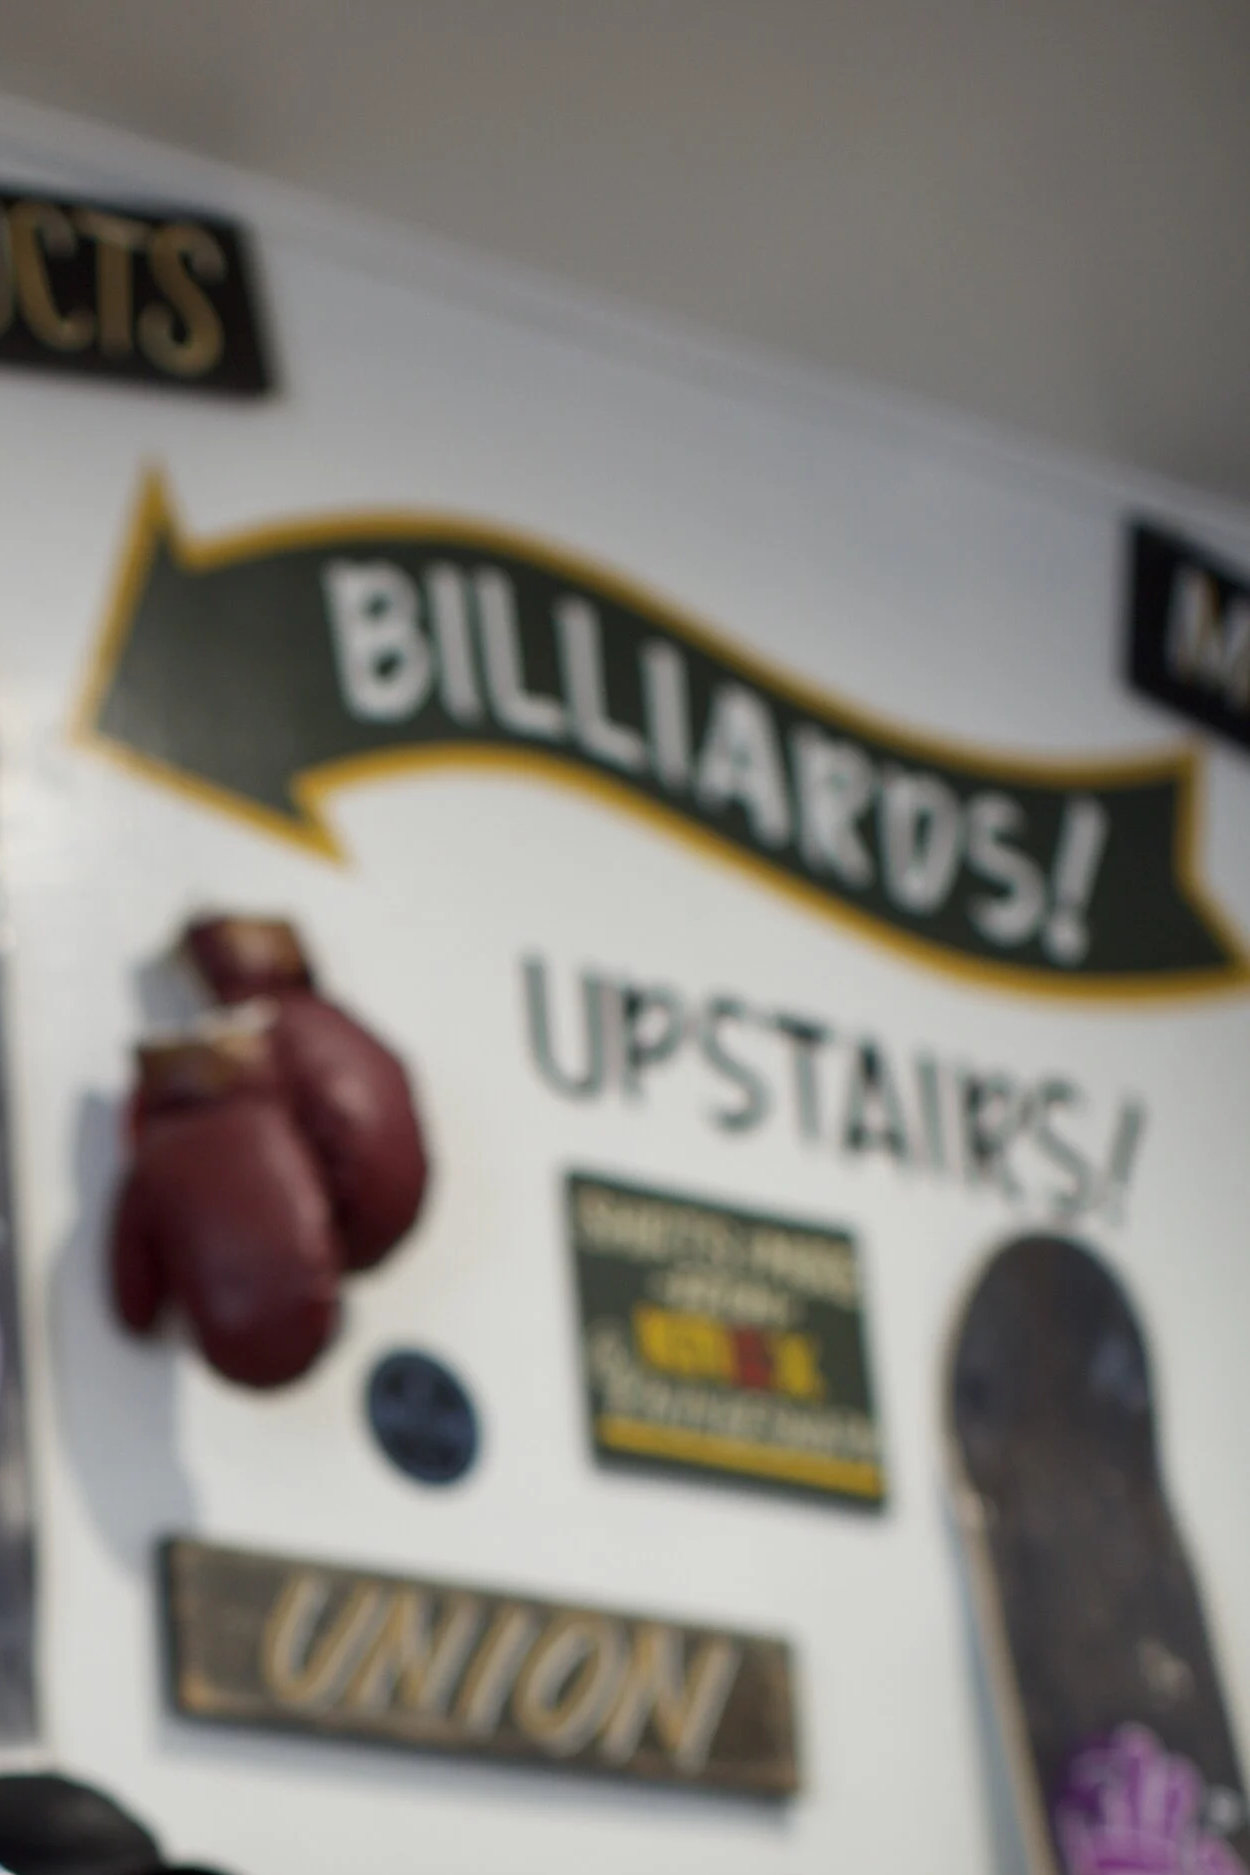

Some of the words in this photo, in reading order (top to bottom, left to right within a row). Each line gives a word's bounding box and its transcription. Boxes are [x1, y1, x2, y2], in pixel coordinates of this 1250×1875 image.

[322, 556, 1110, 966] BILLIARDS!
[520, 952, 1146, 1226] UPSTAIRS!
[260, 1568, 742, 1778] UNION
